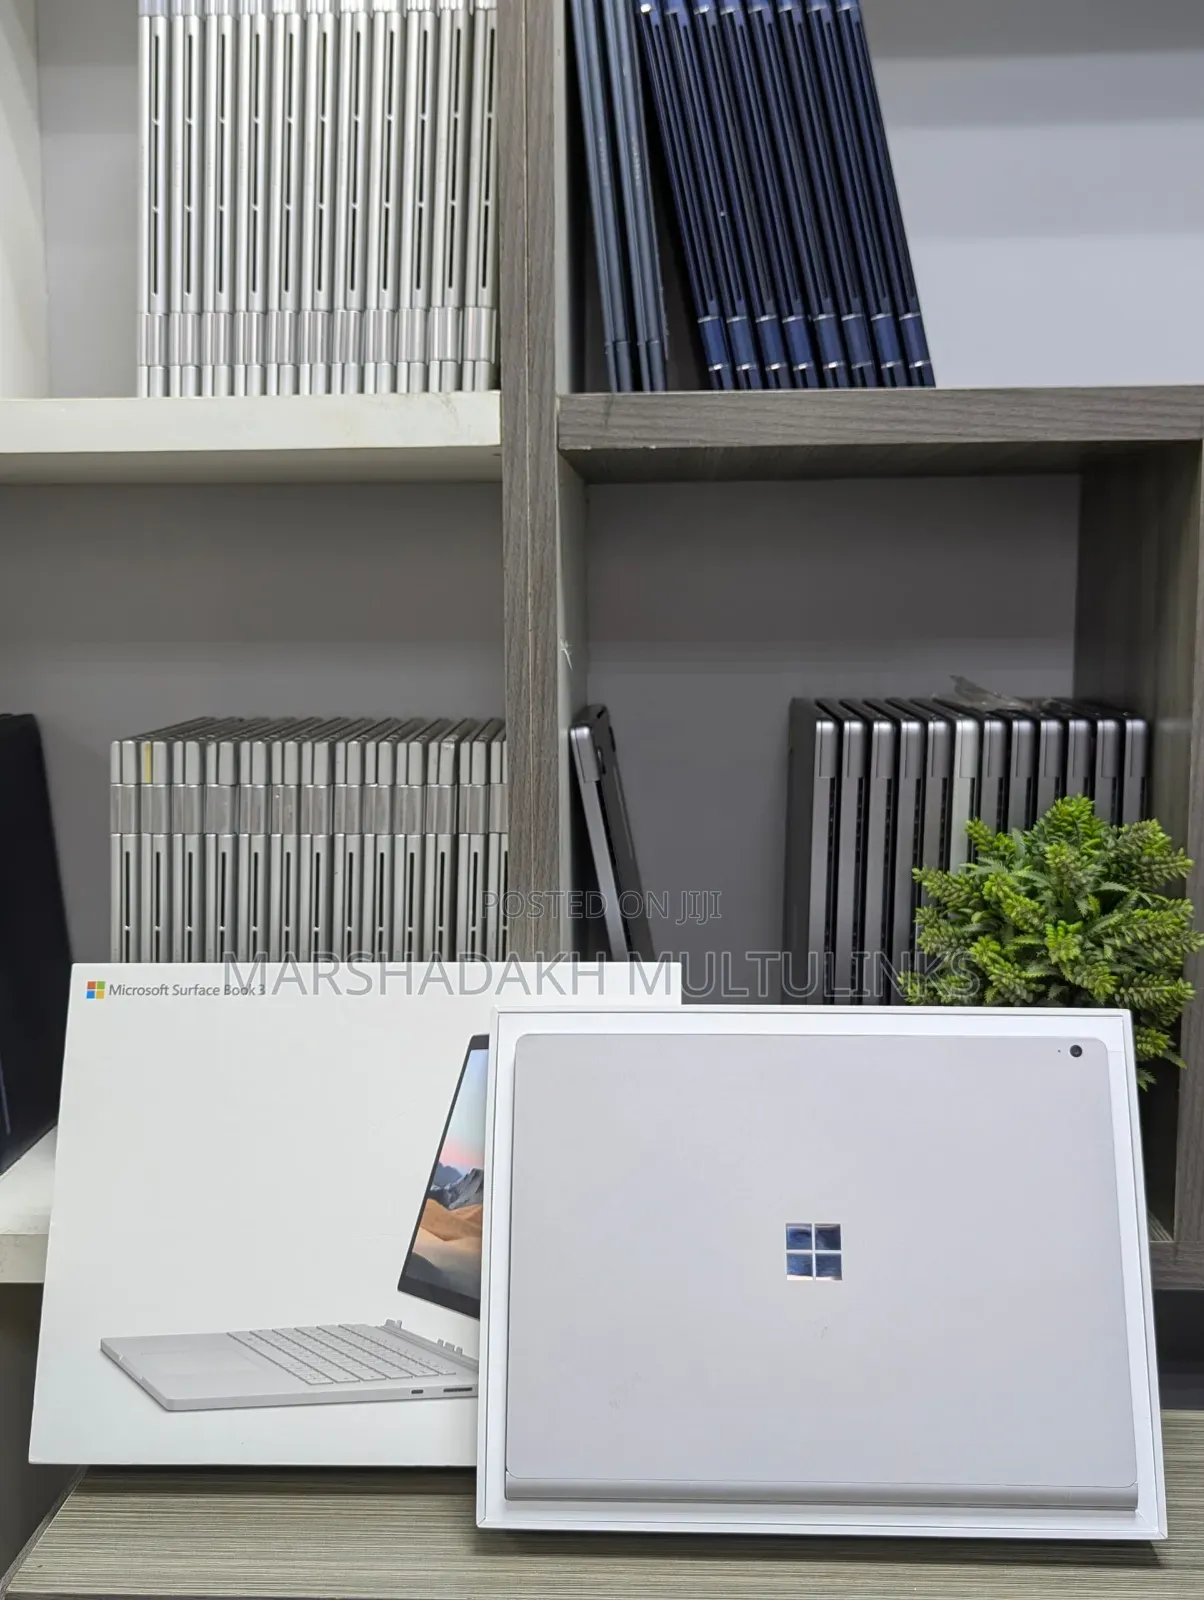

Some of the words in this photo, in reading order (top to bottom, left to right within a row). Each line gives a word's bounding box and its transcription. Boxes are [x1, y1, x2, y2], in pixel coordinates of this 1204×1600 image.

[108, 983, 170, 997] Microsoft
[172, 983, 220, 997] Surface
[223, 983, 256, 997] Book
[258, 984, 266, 996] 3
